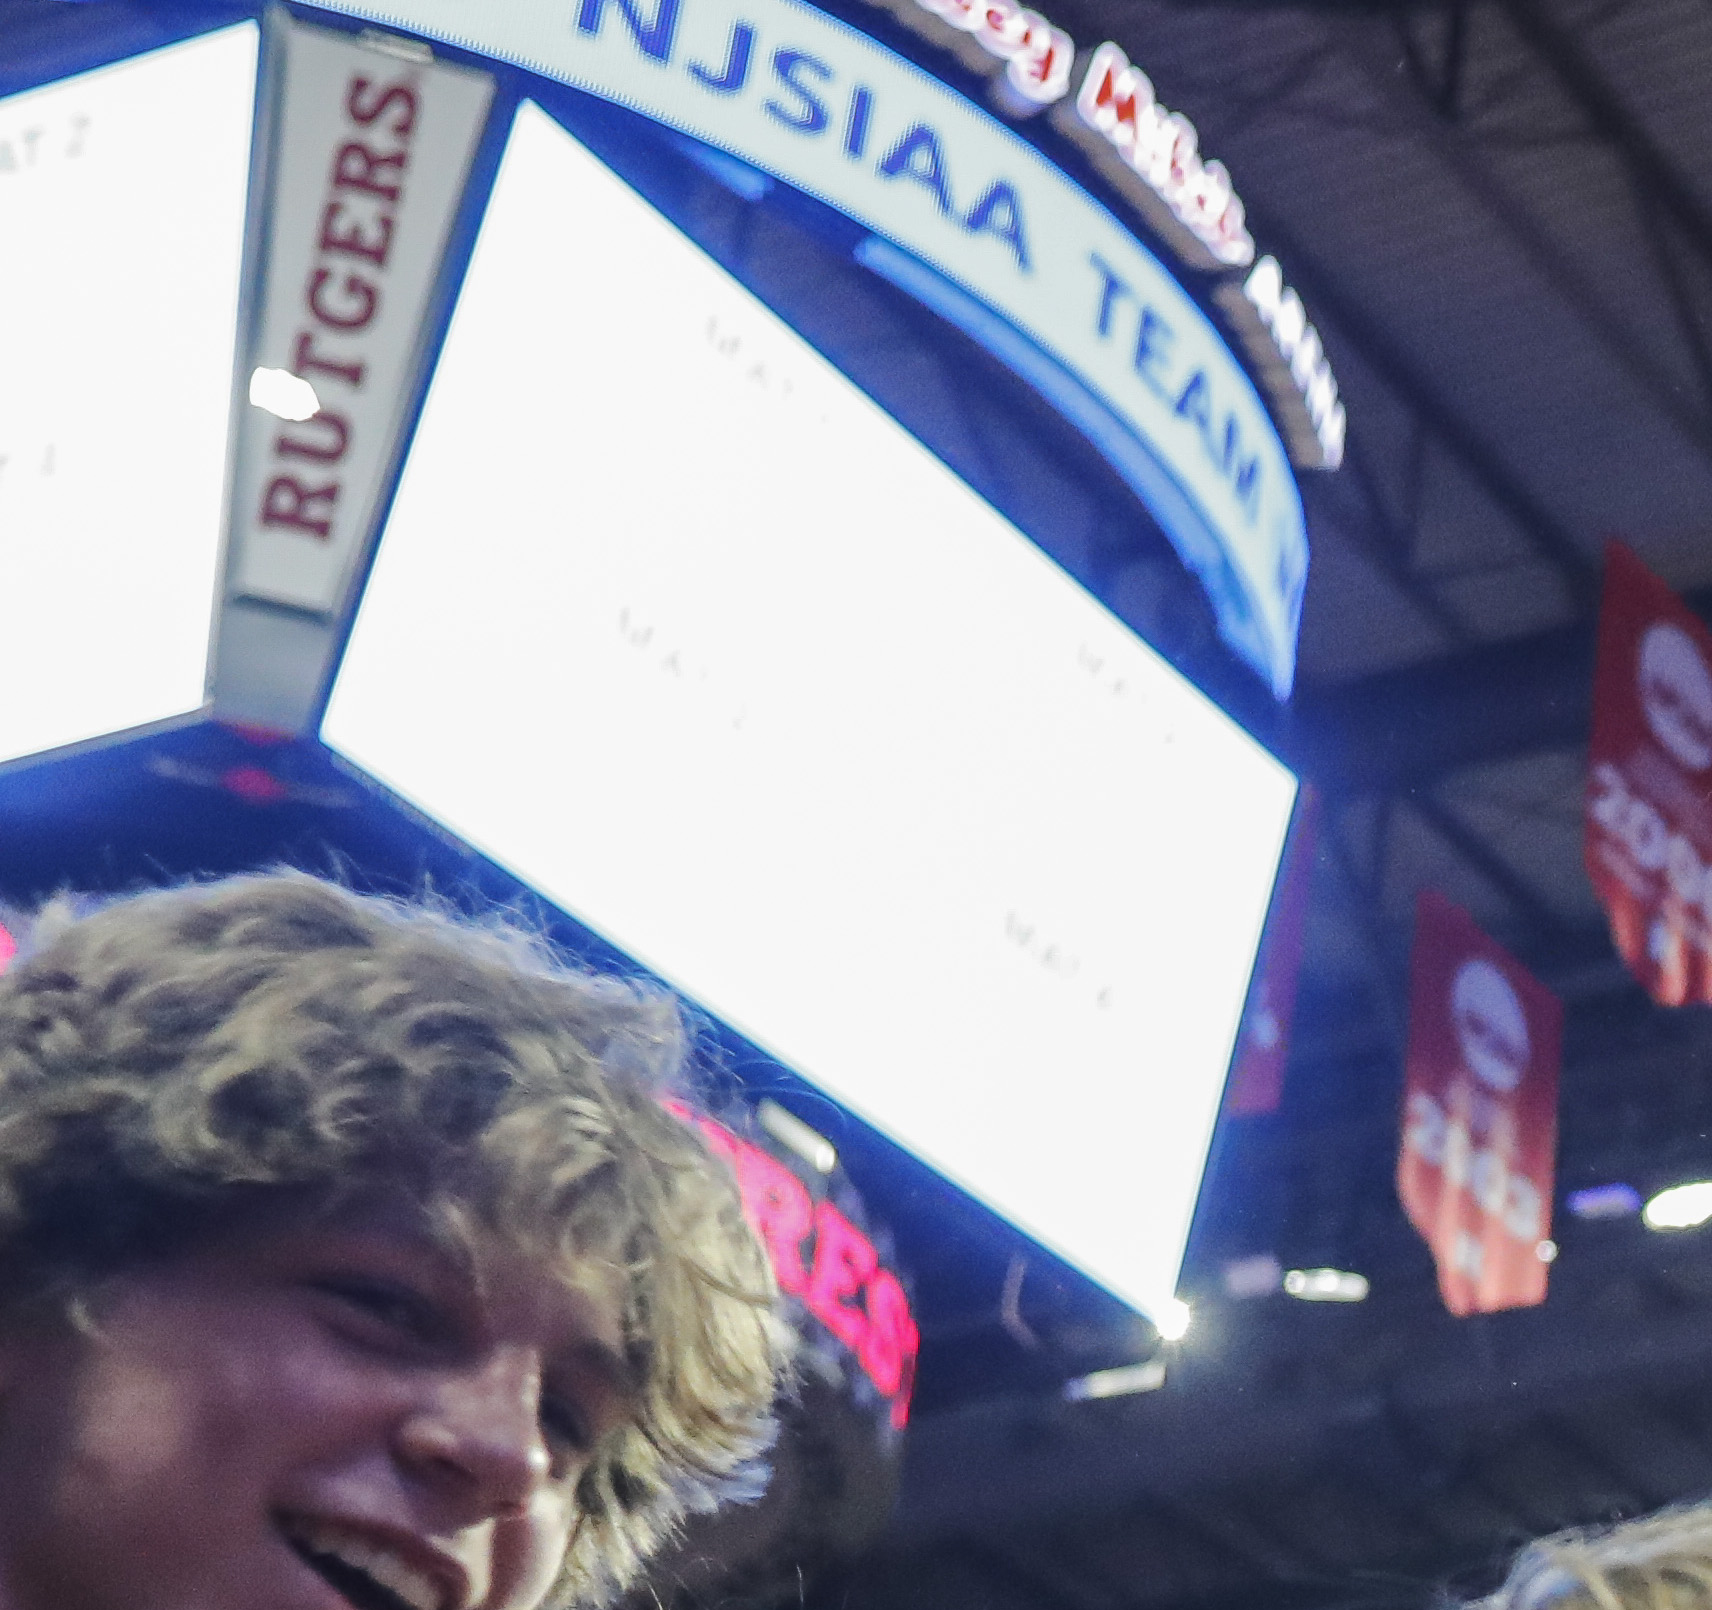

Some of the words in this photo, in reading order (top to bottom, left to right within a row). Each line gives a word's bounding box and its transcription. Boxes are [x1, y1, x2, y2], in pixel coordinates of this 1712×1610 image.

[257, 72, 425, 543] RUTGERS
[577, 0, 1034, 275] NJSIAA
[1089, 251, 1262, 530] TEAM
